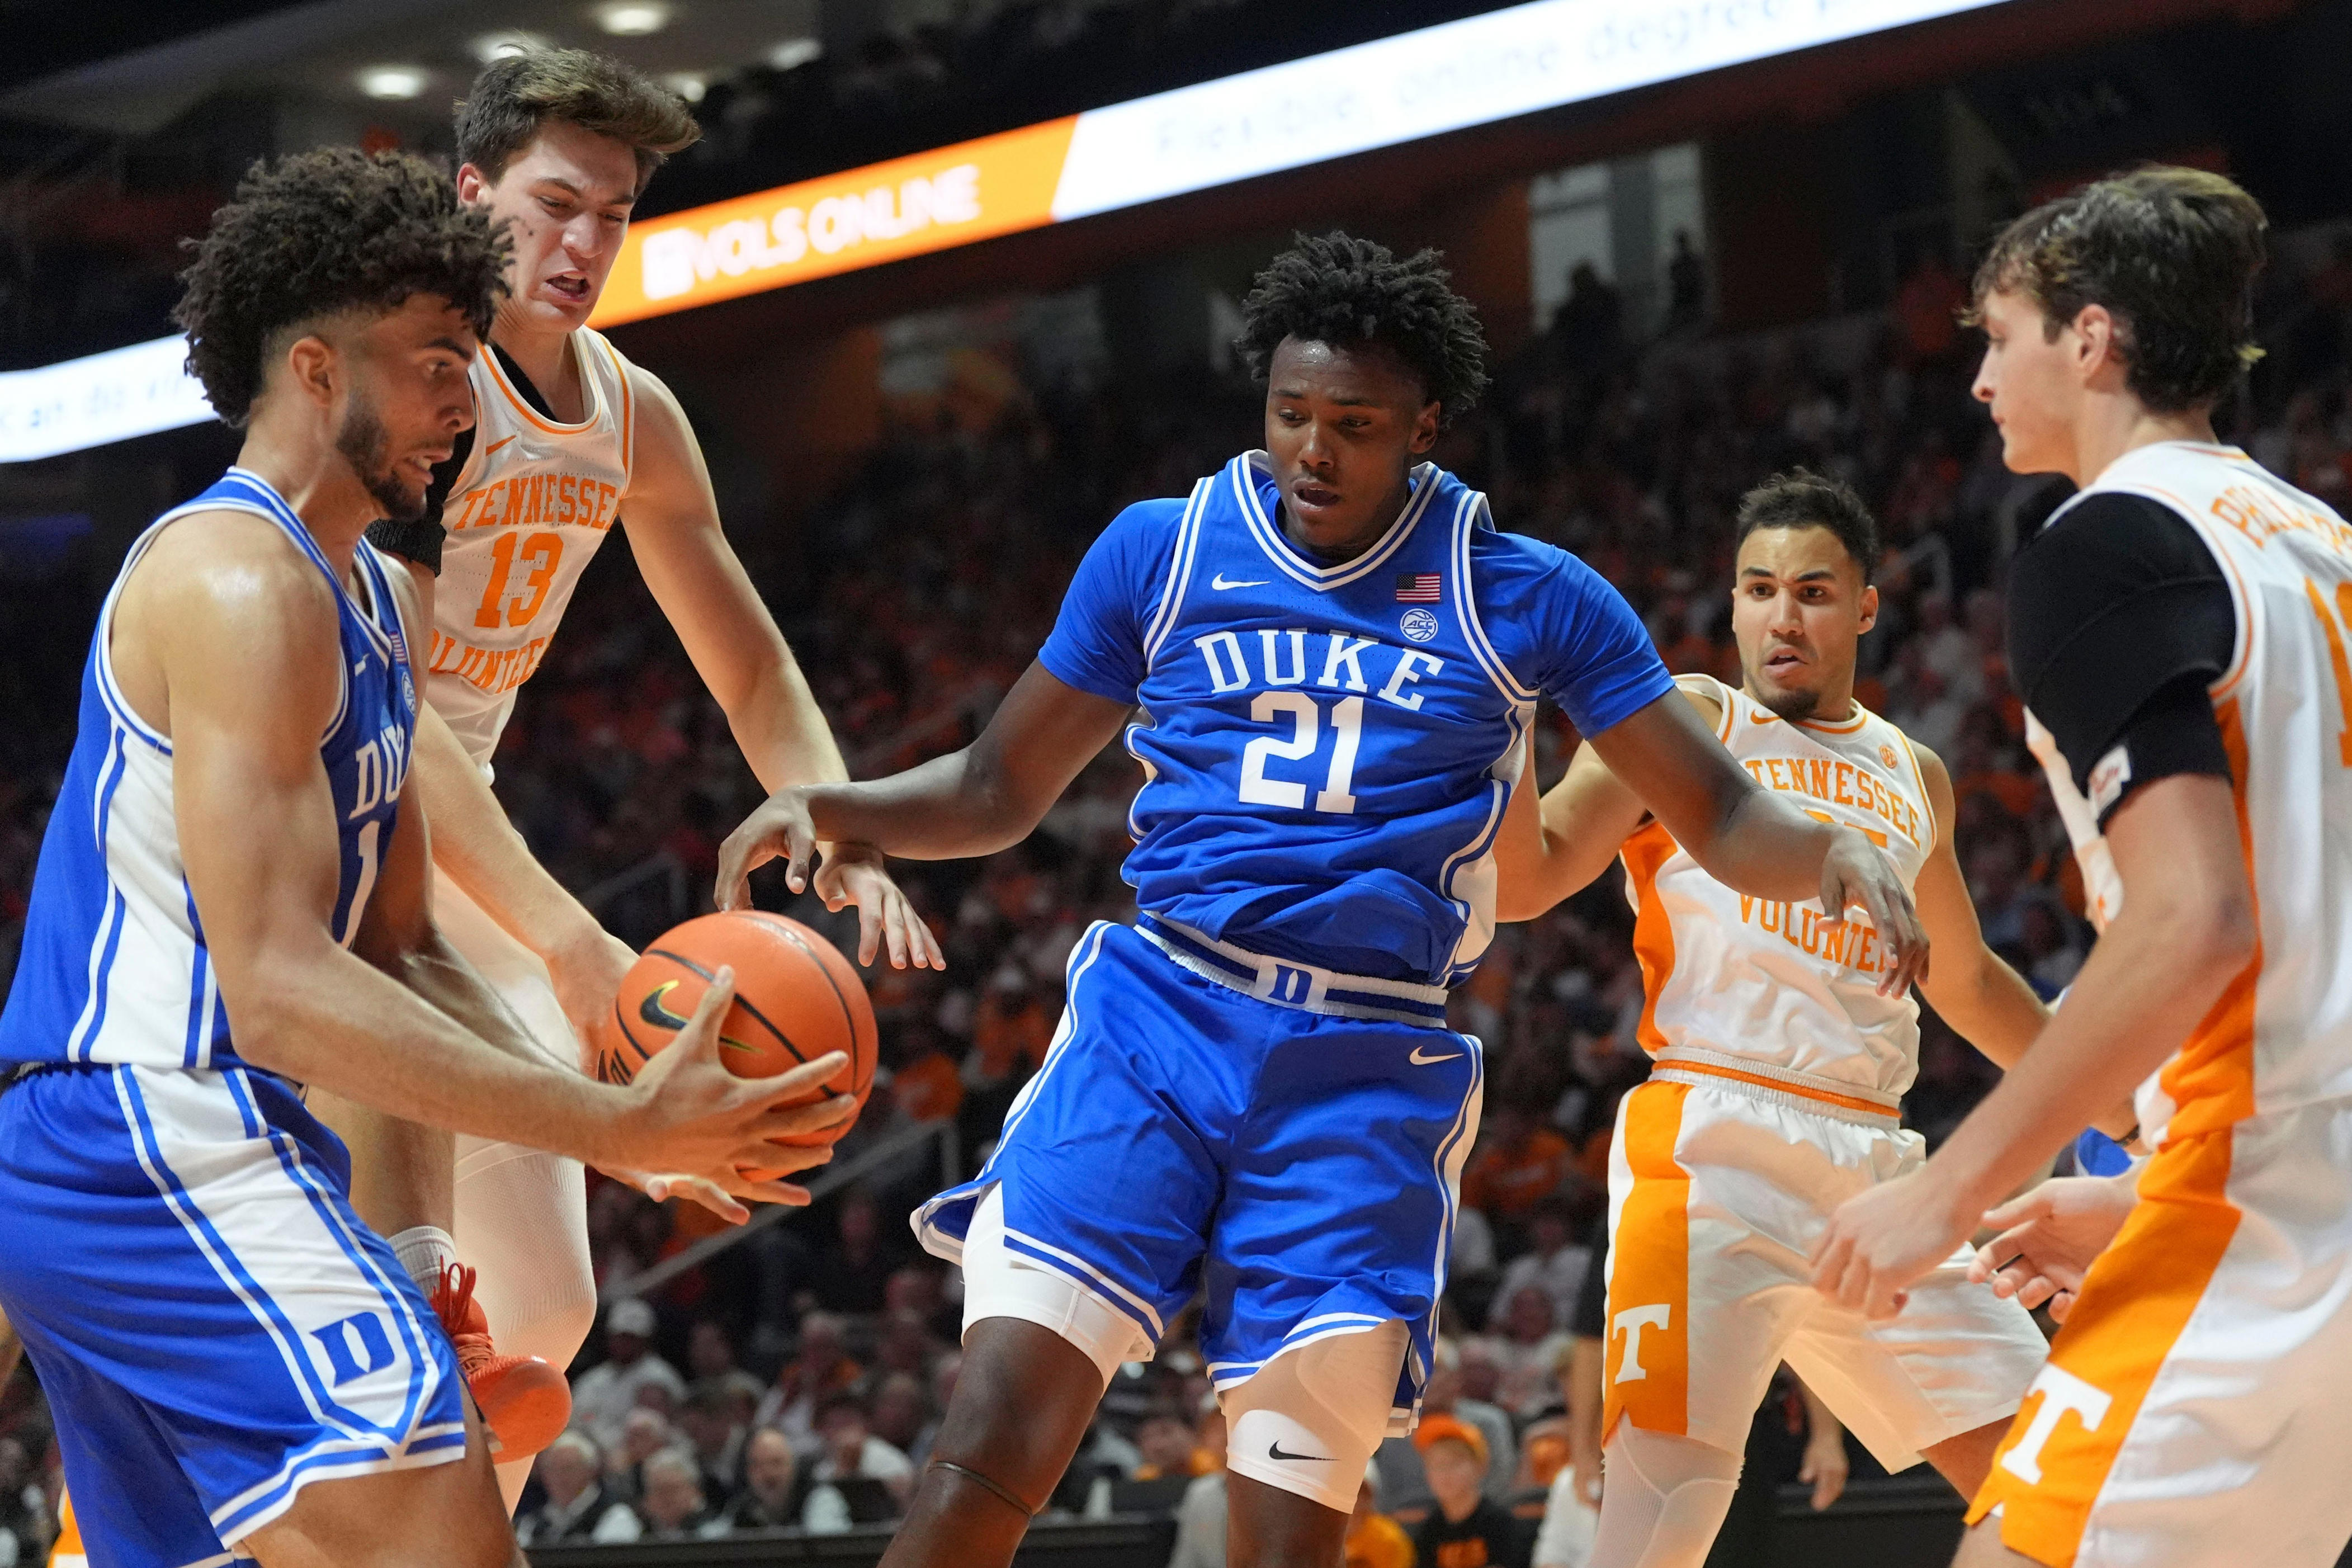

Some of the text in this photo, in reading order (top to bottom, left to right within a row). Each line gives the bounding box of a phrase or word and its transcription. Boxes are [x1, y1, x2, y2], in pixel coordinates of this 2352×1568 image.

[691, 206, 808, 282] VOLS
[808, 163, 983, 254] ONLINE
[454, 474, 619, 531] TENNESSE
[474, 532, 563, 629] 13
[1406, 620, 1434, 630] ACC
[1194, 628, 1444, 711] DUKE
[2304, 575, 2352, 768] 1
[1239, 691, 1365, 814] 21
[1745, 758, 1921, 851] TENNESSEE
[341, 820, 380, 948] 1
[1268, 963, 1313, 1005] D
[310, 1311, 396, 1388] D
[1612, 1303, 1671, 1386] T
[2000, 1361, 2113, 1485] T
